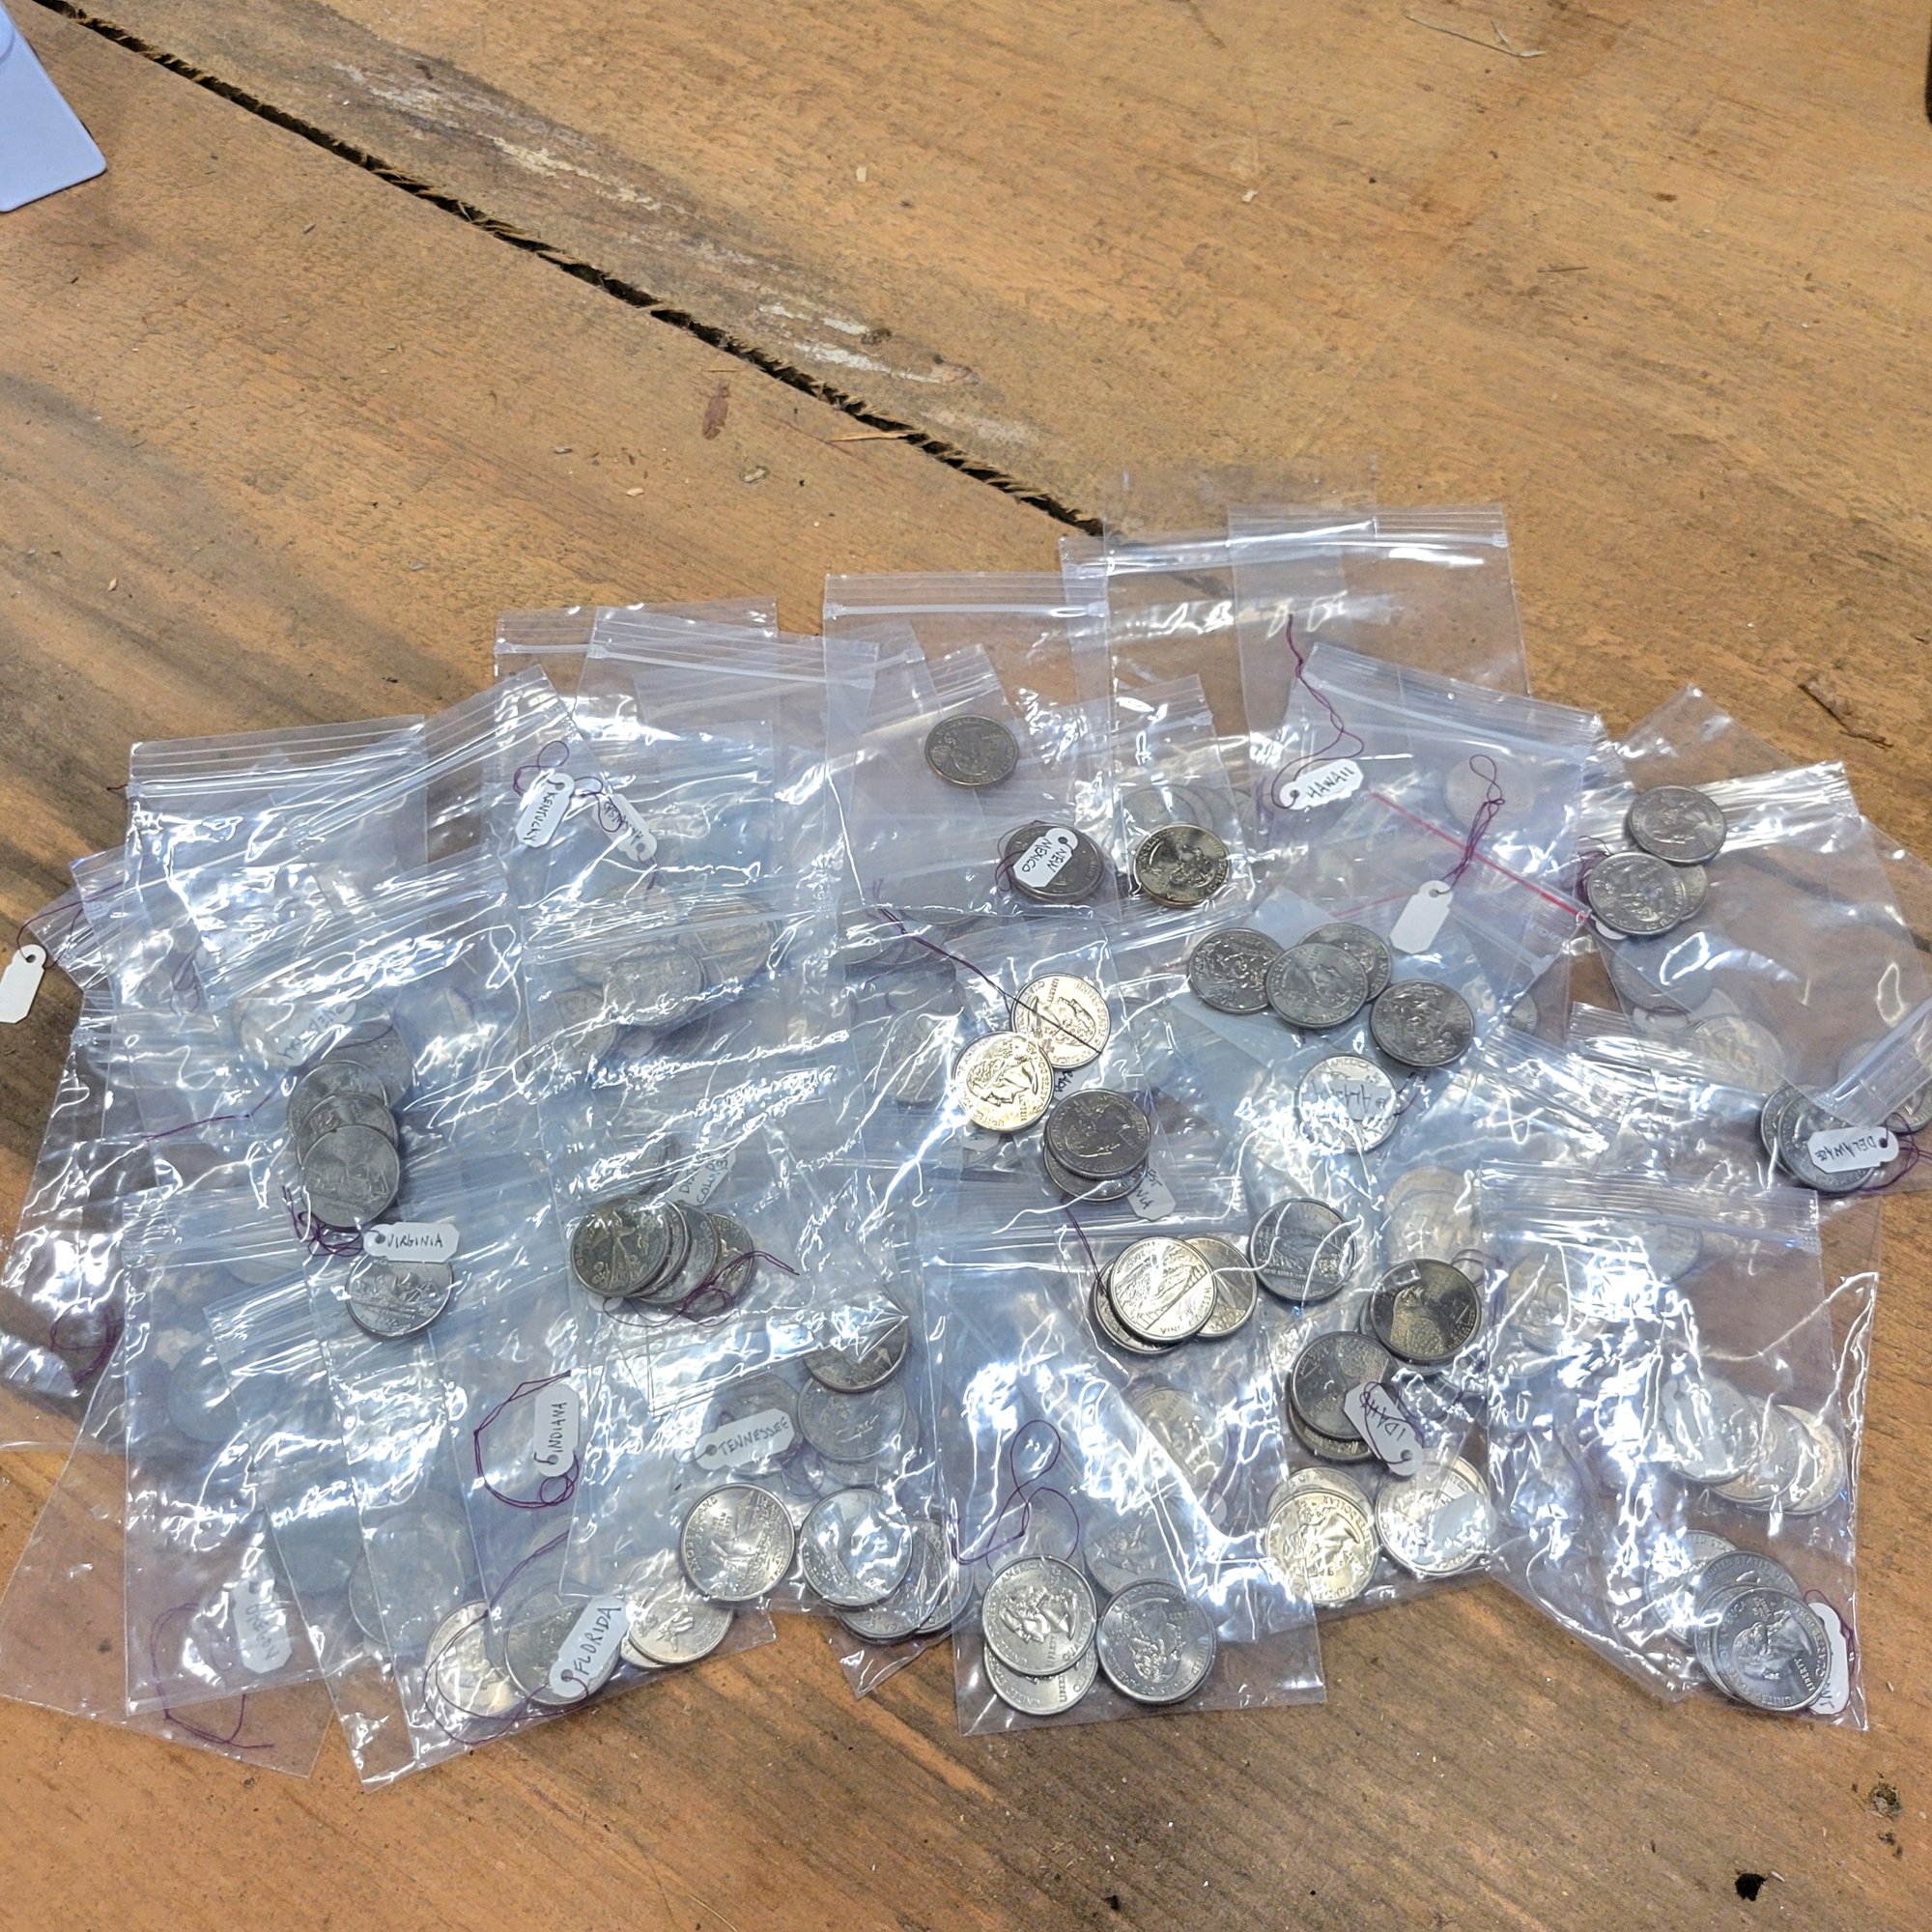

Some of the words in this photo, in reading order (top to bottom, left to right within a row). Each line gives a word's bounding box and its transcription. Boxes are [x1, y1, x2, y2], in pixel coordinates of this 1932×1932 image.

[1306, 767, 1354, 798] HAWAII
[524, 792, 558, 841] KENTUCKY
[1022, 838, 1053, 872] MEXICO
[1046, 848, 1067, 872] NEW
[1815, 1136, 1878, 1161] DELAWARE
[387, 1233, 443, 1248] VIRGINIA
[548, 1402, 568, 1453] INDIANA
[719, 1416, 788, 1456] TENNESSEE
[574, 1607, 621, 1675] FLORIDA
[1793, 1658, 1816, 1692] LIBERTY
